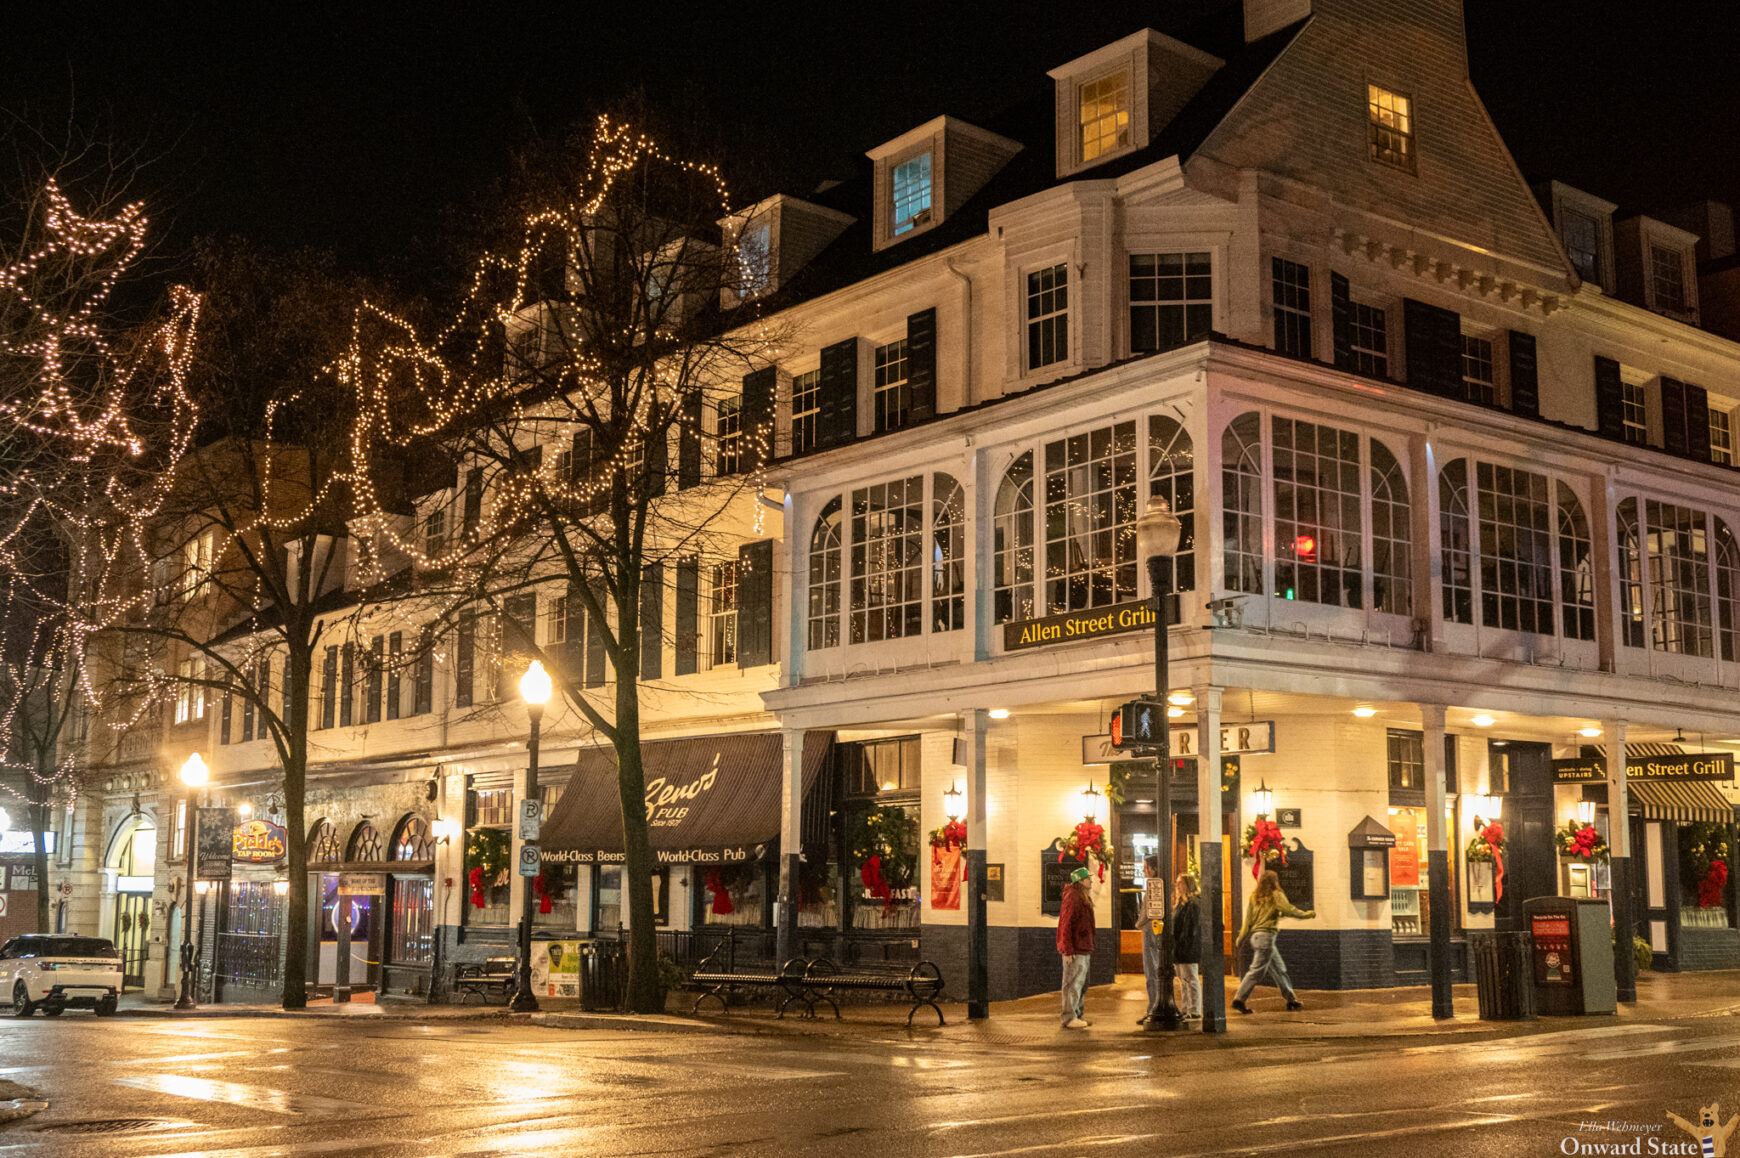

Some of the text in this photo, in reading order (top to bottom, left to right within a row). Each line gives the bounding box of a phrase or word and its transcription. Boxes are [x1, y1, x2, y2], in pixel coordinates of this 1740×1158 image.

[1019, 623, 1062, 645] Allen
[1065, 612, 1114, 637] Street
[1646, 762, 1689, 776] Street
[1692, 759, 1726, 775] Grill
[655, 807, 690, 819] PUB
[252, 850, 276, 858] ROOM
[540, 850, 626, 862] World-Class Beers
[657, 848, 746, 863] World-Class Pub
